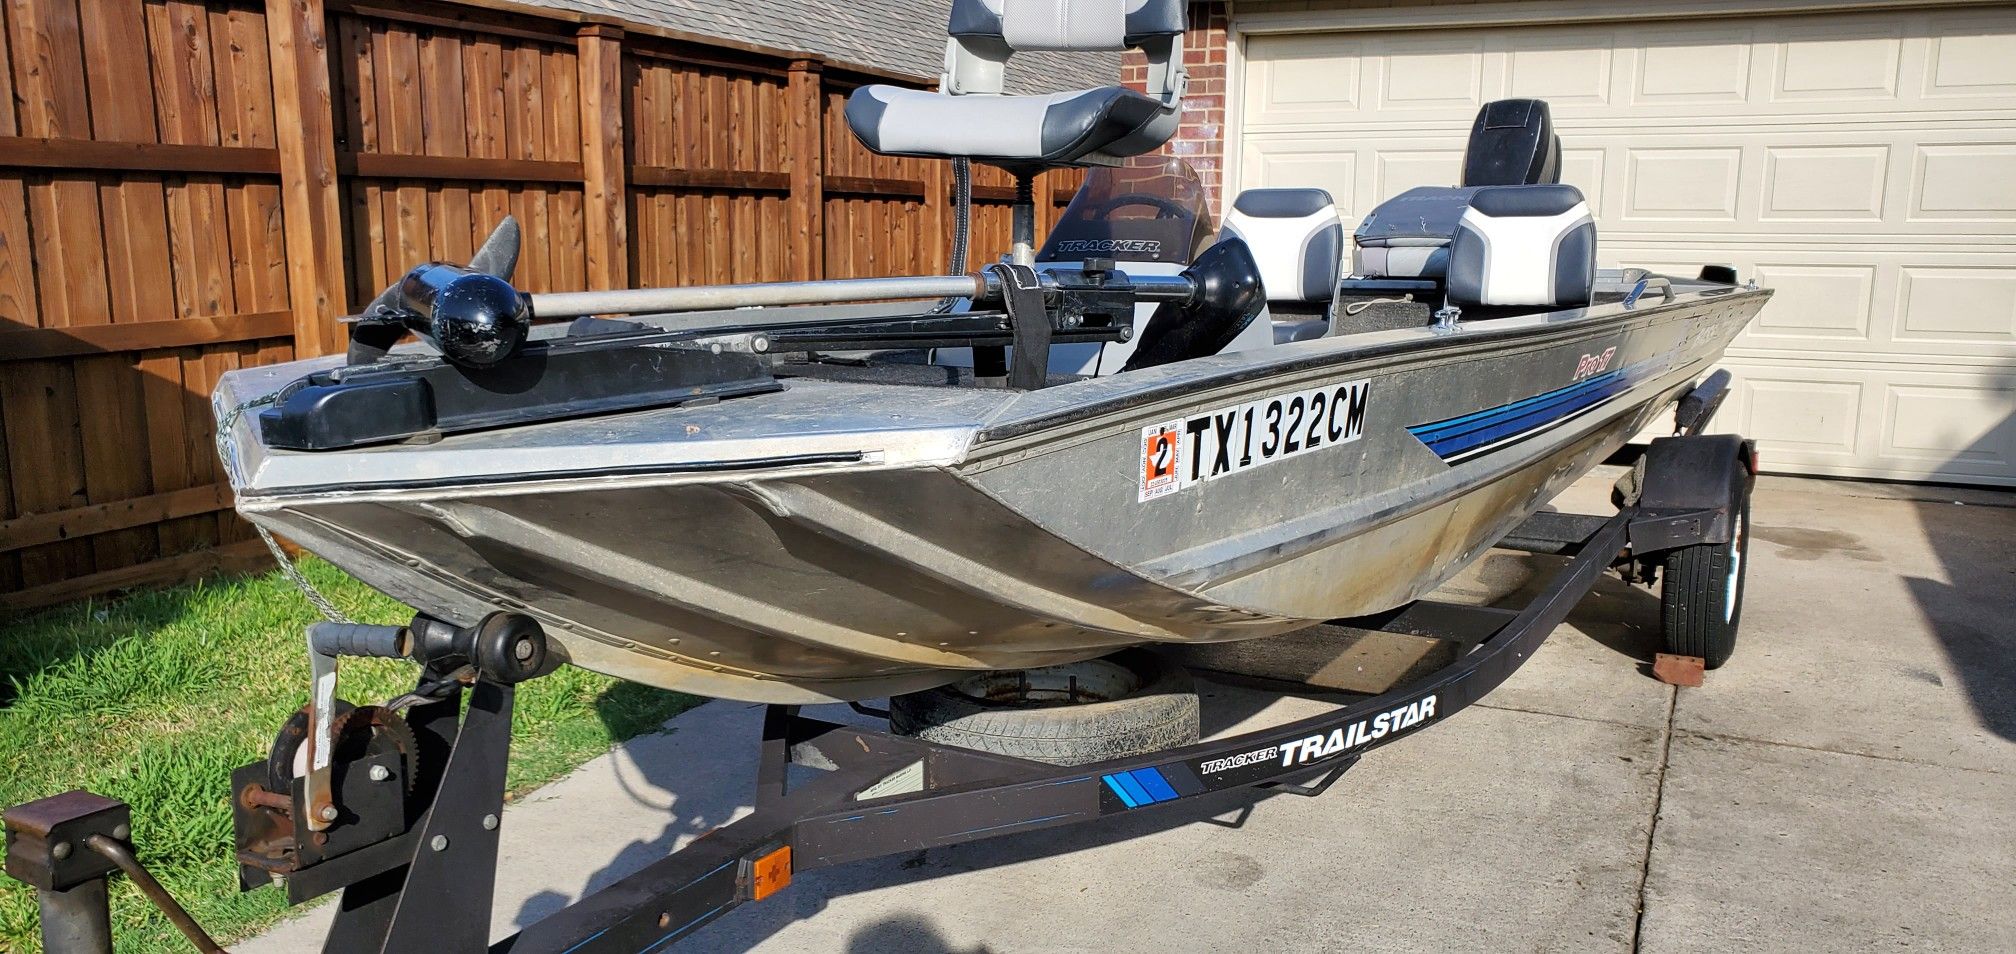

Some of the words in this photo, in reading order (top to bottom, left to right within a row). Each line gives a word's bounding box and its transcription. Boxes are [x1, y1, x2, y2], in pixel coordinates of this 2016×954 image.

[1059, 240, 1160, 252] TRACKER
[1572, 354, 1600, 381] Pro
[1154, 437, 1168, 477] 2
[1201, 747, 1278, 775] TRACKER
[1279, 694, 1437, 767] TRAILSTAR
